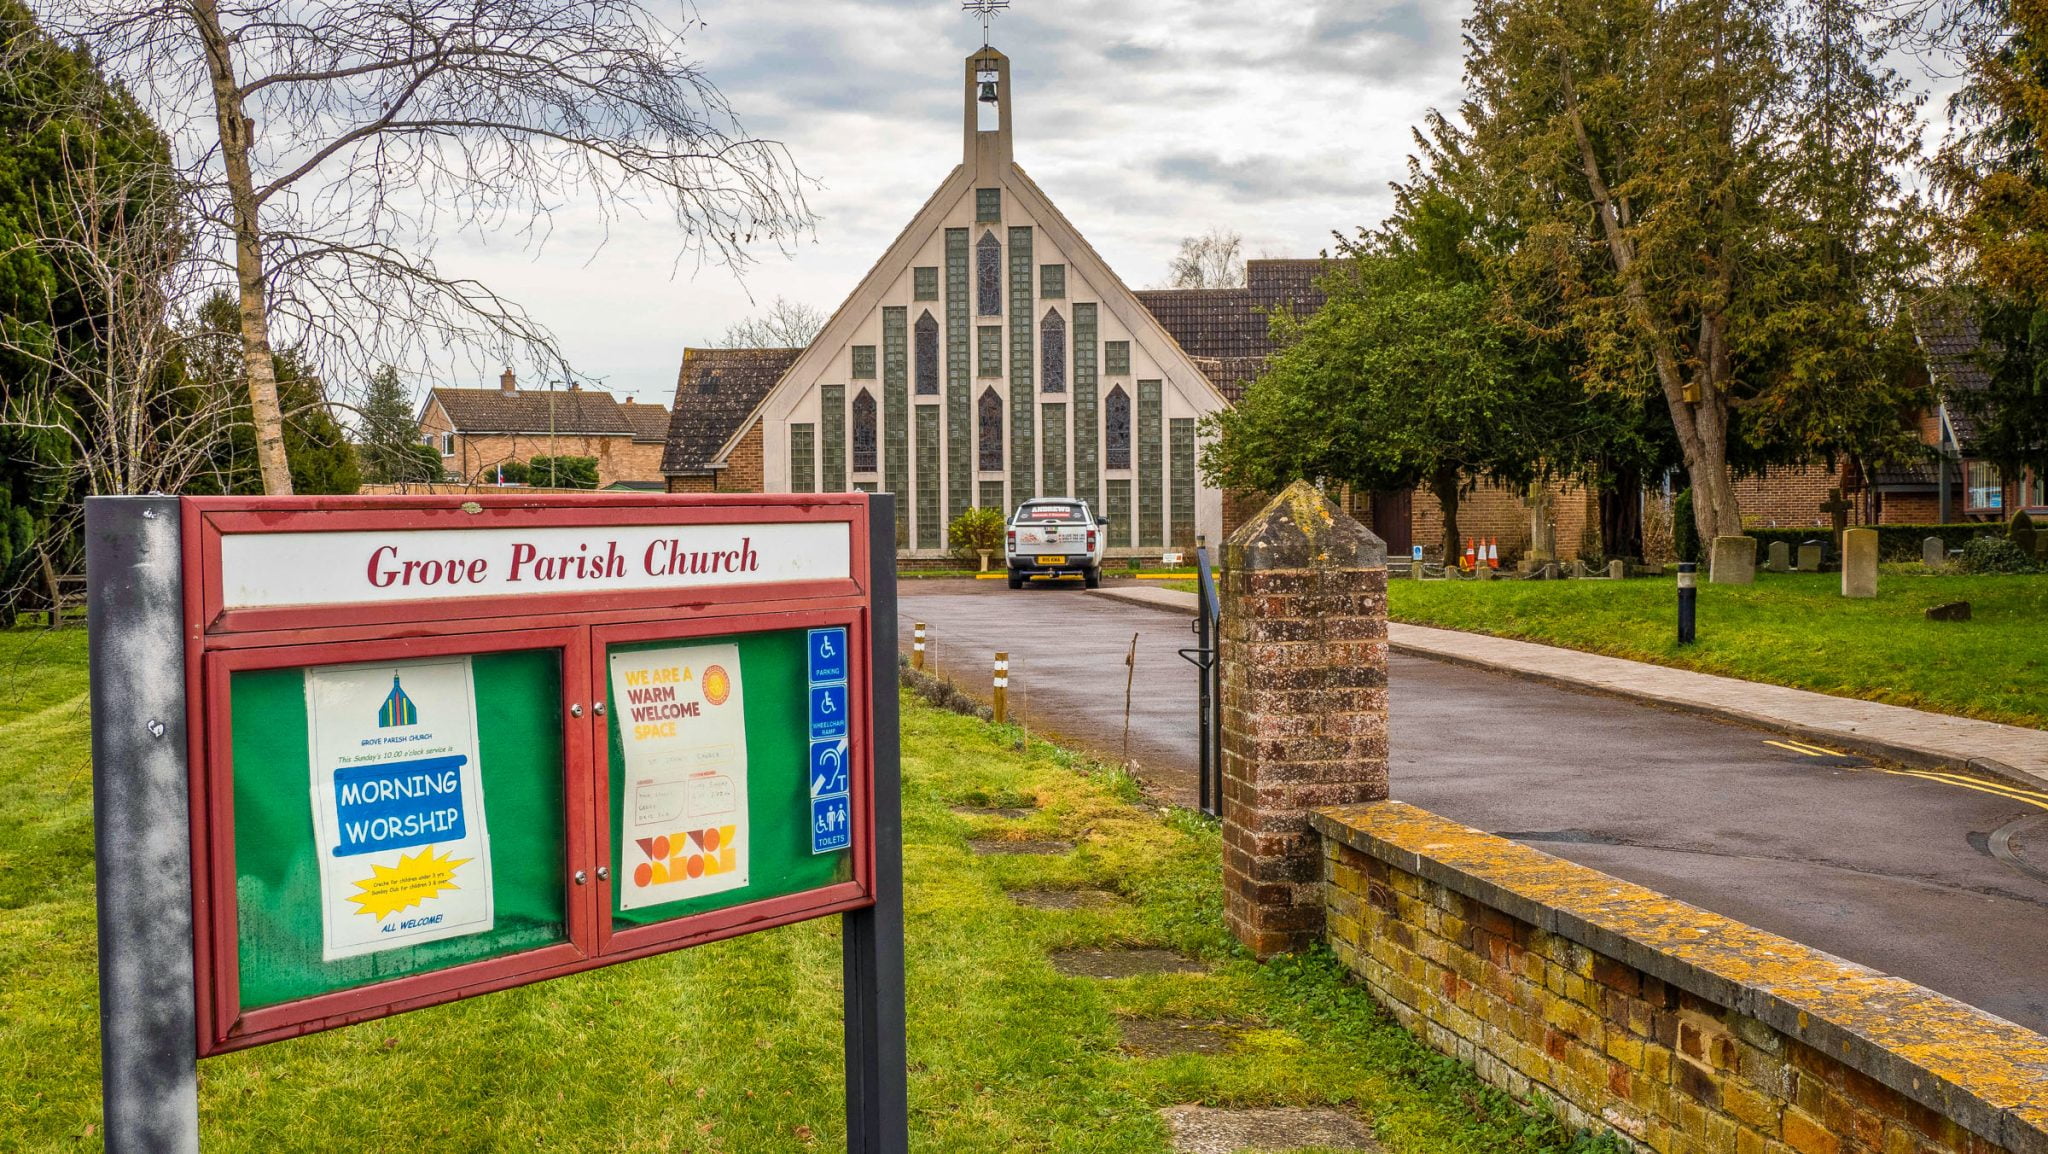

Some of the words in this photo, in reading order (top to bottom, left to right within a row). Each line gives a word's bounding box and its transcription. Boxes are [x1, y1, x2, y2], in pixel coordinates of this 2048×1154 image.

[367, 545, 488, 588] Grove
[506, 541, 627, 582] Parish
[643, 538, 759, 577] Church
[624, 670, 650, 687] WE
[652, 667, 680, 684] ARE
[683, 666, 693, 682] A
[816, 667, 839, 676] PARKING
[627, 686, 676, 705] WARM
[630, 701, 701, 722] WELCOME
[634, 722, 676, 741] SPACE
[813, 720, 844, 729] WHEELCHAIR
[361, 738, 382, 747] GROVE
[383, 736, 407, 744] PARISH
[409, 733, 433, 742] CHURCH
[354, 752, 381, 762] Sunday's
[383, 750, 402, 759] 10.00
[404, 748, 424, 756] o'clock
[426, 746, 446, 754] service
[341, 771, 457, 807] MORNING
[837, 774, 846, 791] T
[345, 808, 458, 844] WORSHIP
[818, 834, 845, 846] TOILETS
[400, 876, 418, 884] children
[409, 882, 427, 890] children
[381, 922, 396, 934] ALL
[400, 913, 444, 930] WELCOME!
